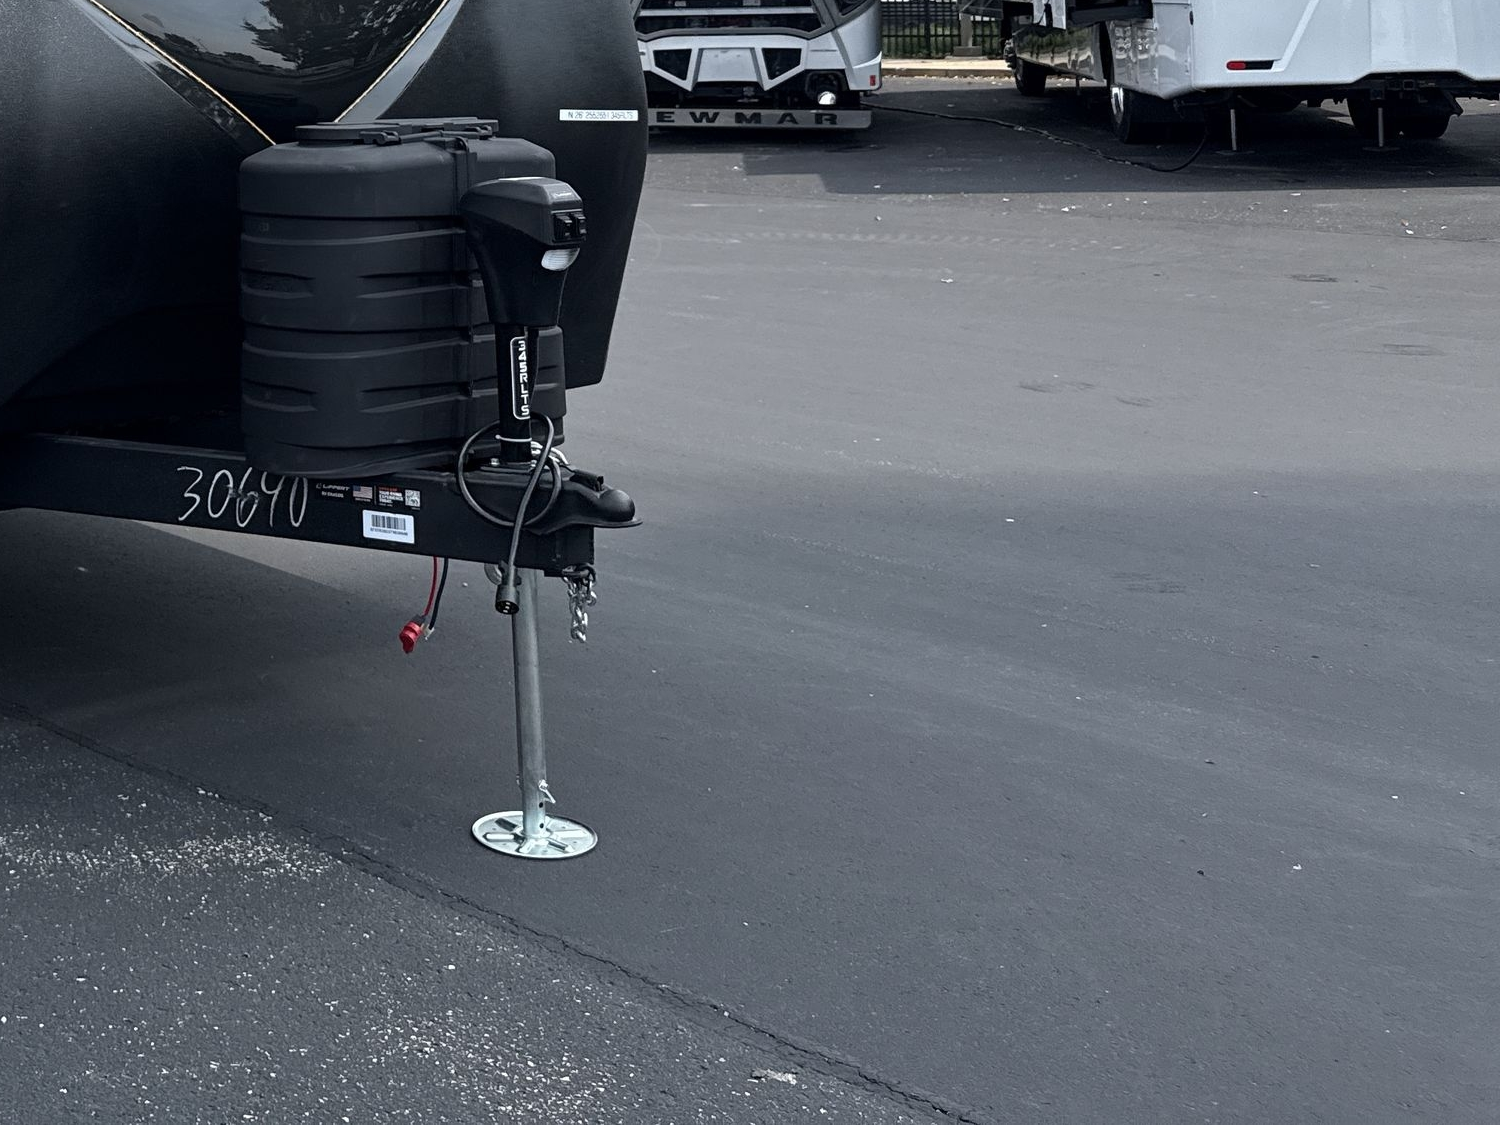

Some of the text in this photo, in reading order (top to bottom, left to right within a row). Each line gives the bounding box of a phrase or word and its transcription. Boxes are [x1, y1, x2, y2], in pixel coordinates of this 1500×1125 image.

[655, 111, 838, 125] EWMAR
[518, 340, 530, 416] 345RLTS
[176, 465, 308, 528] 30640
